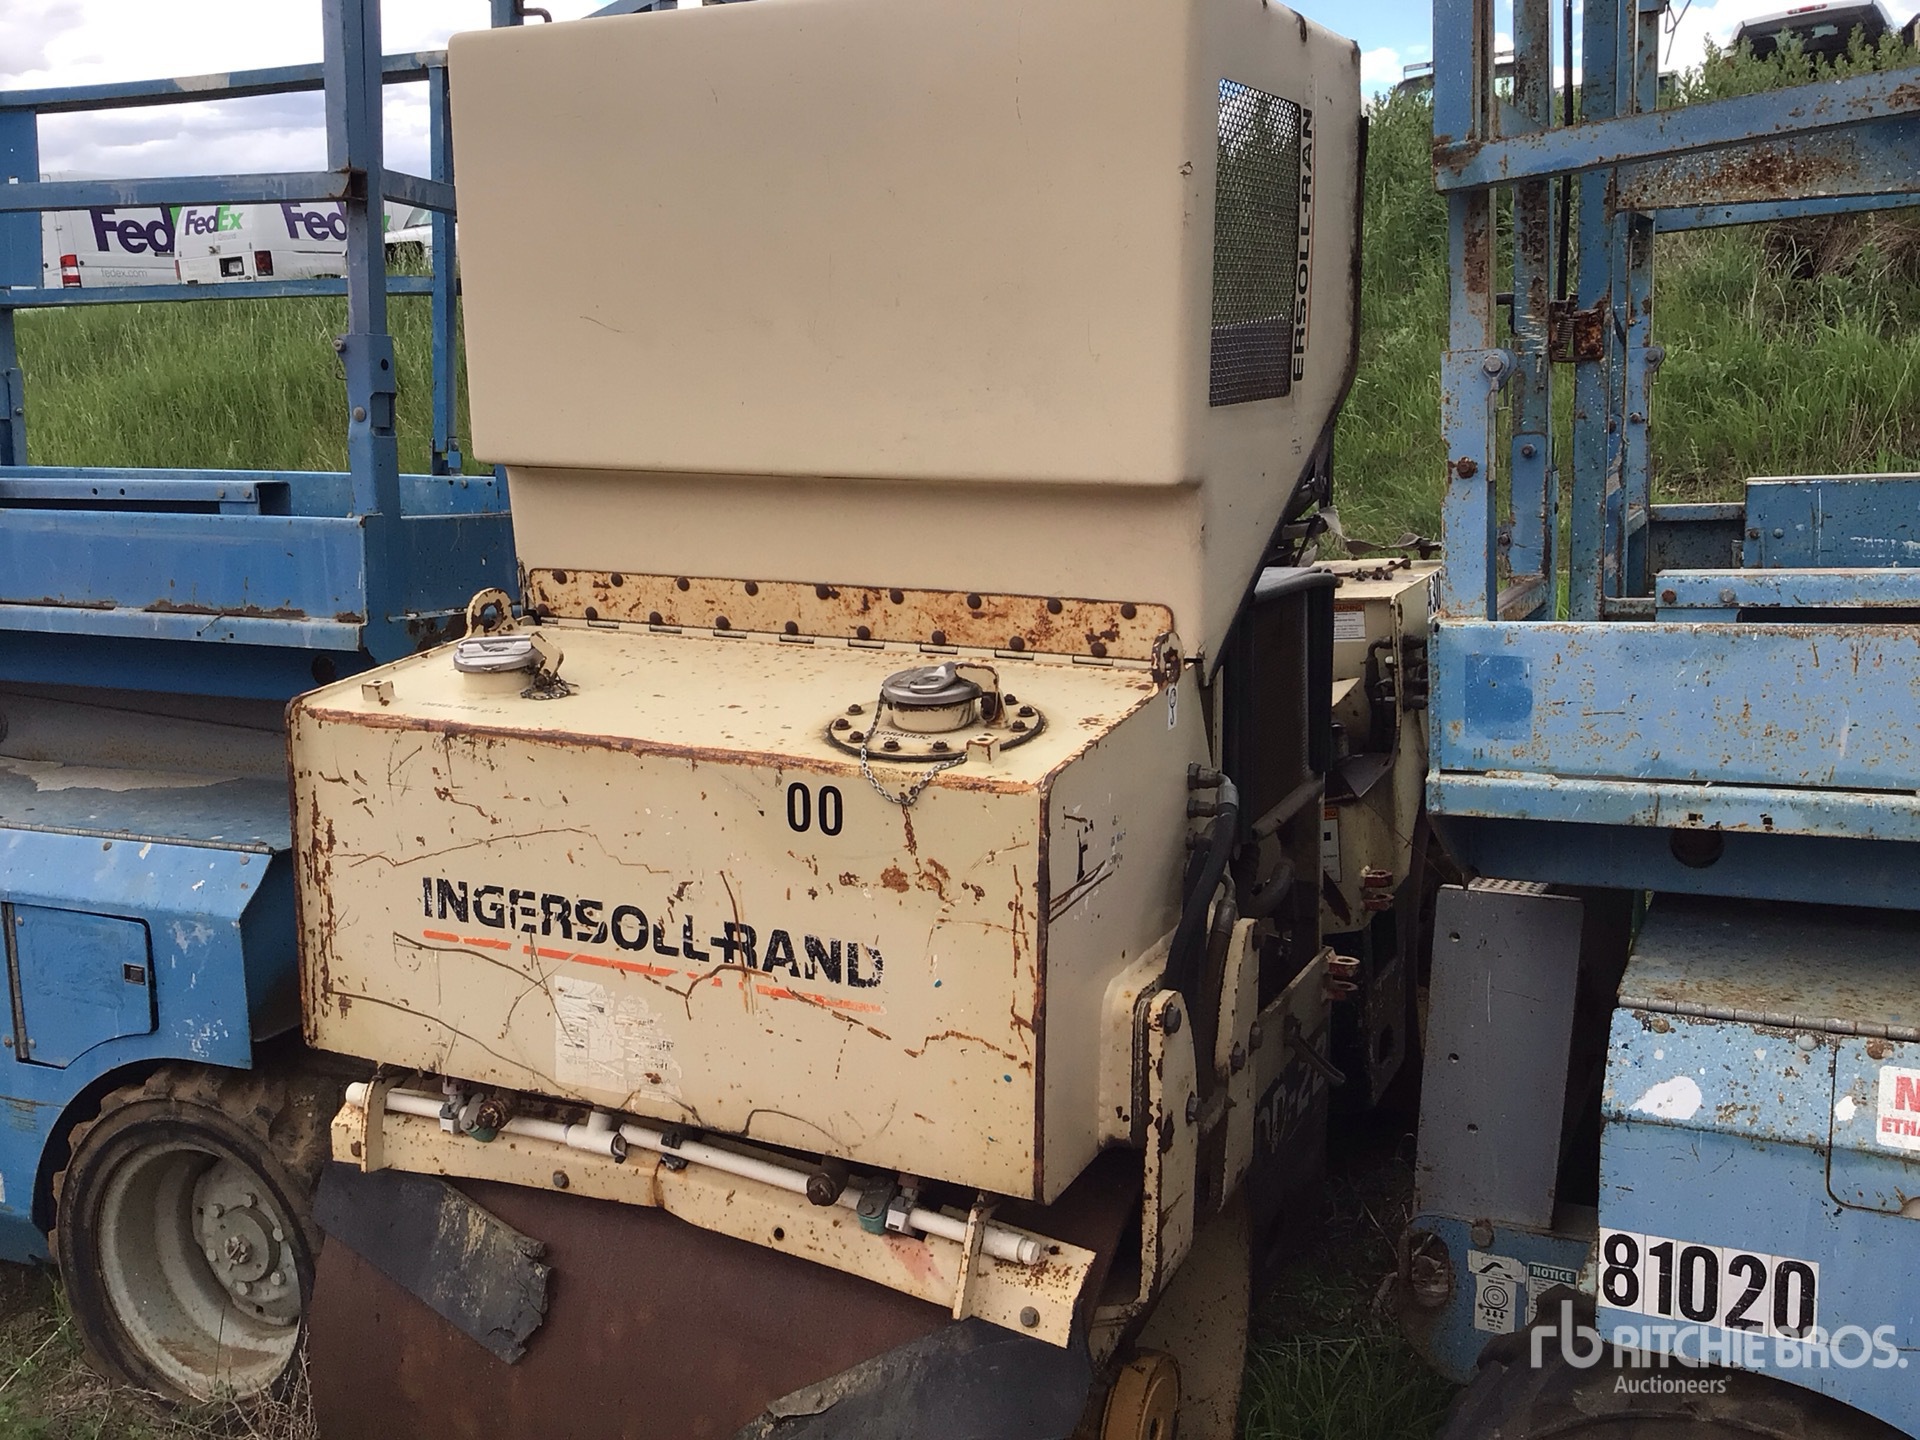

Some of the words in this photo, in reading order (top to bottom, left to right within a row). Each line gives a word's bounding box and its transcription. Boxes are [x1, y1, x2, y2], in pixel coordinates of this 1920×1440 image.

[185, 204, 243, 236] FedEx
[786, 782, 843, 836] 00
[1532, 1265, 1572, 1282] NOTICE
[1602, 1233, 1816, 1340] 81020
